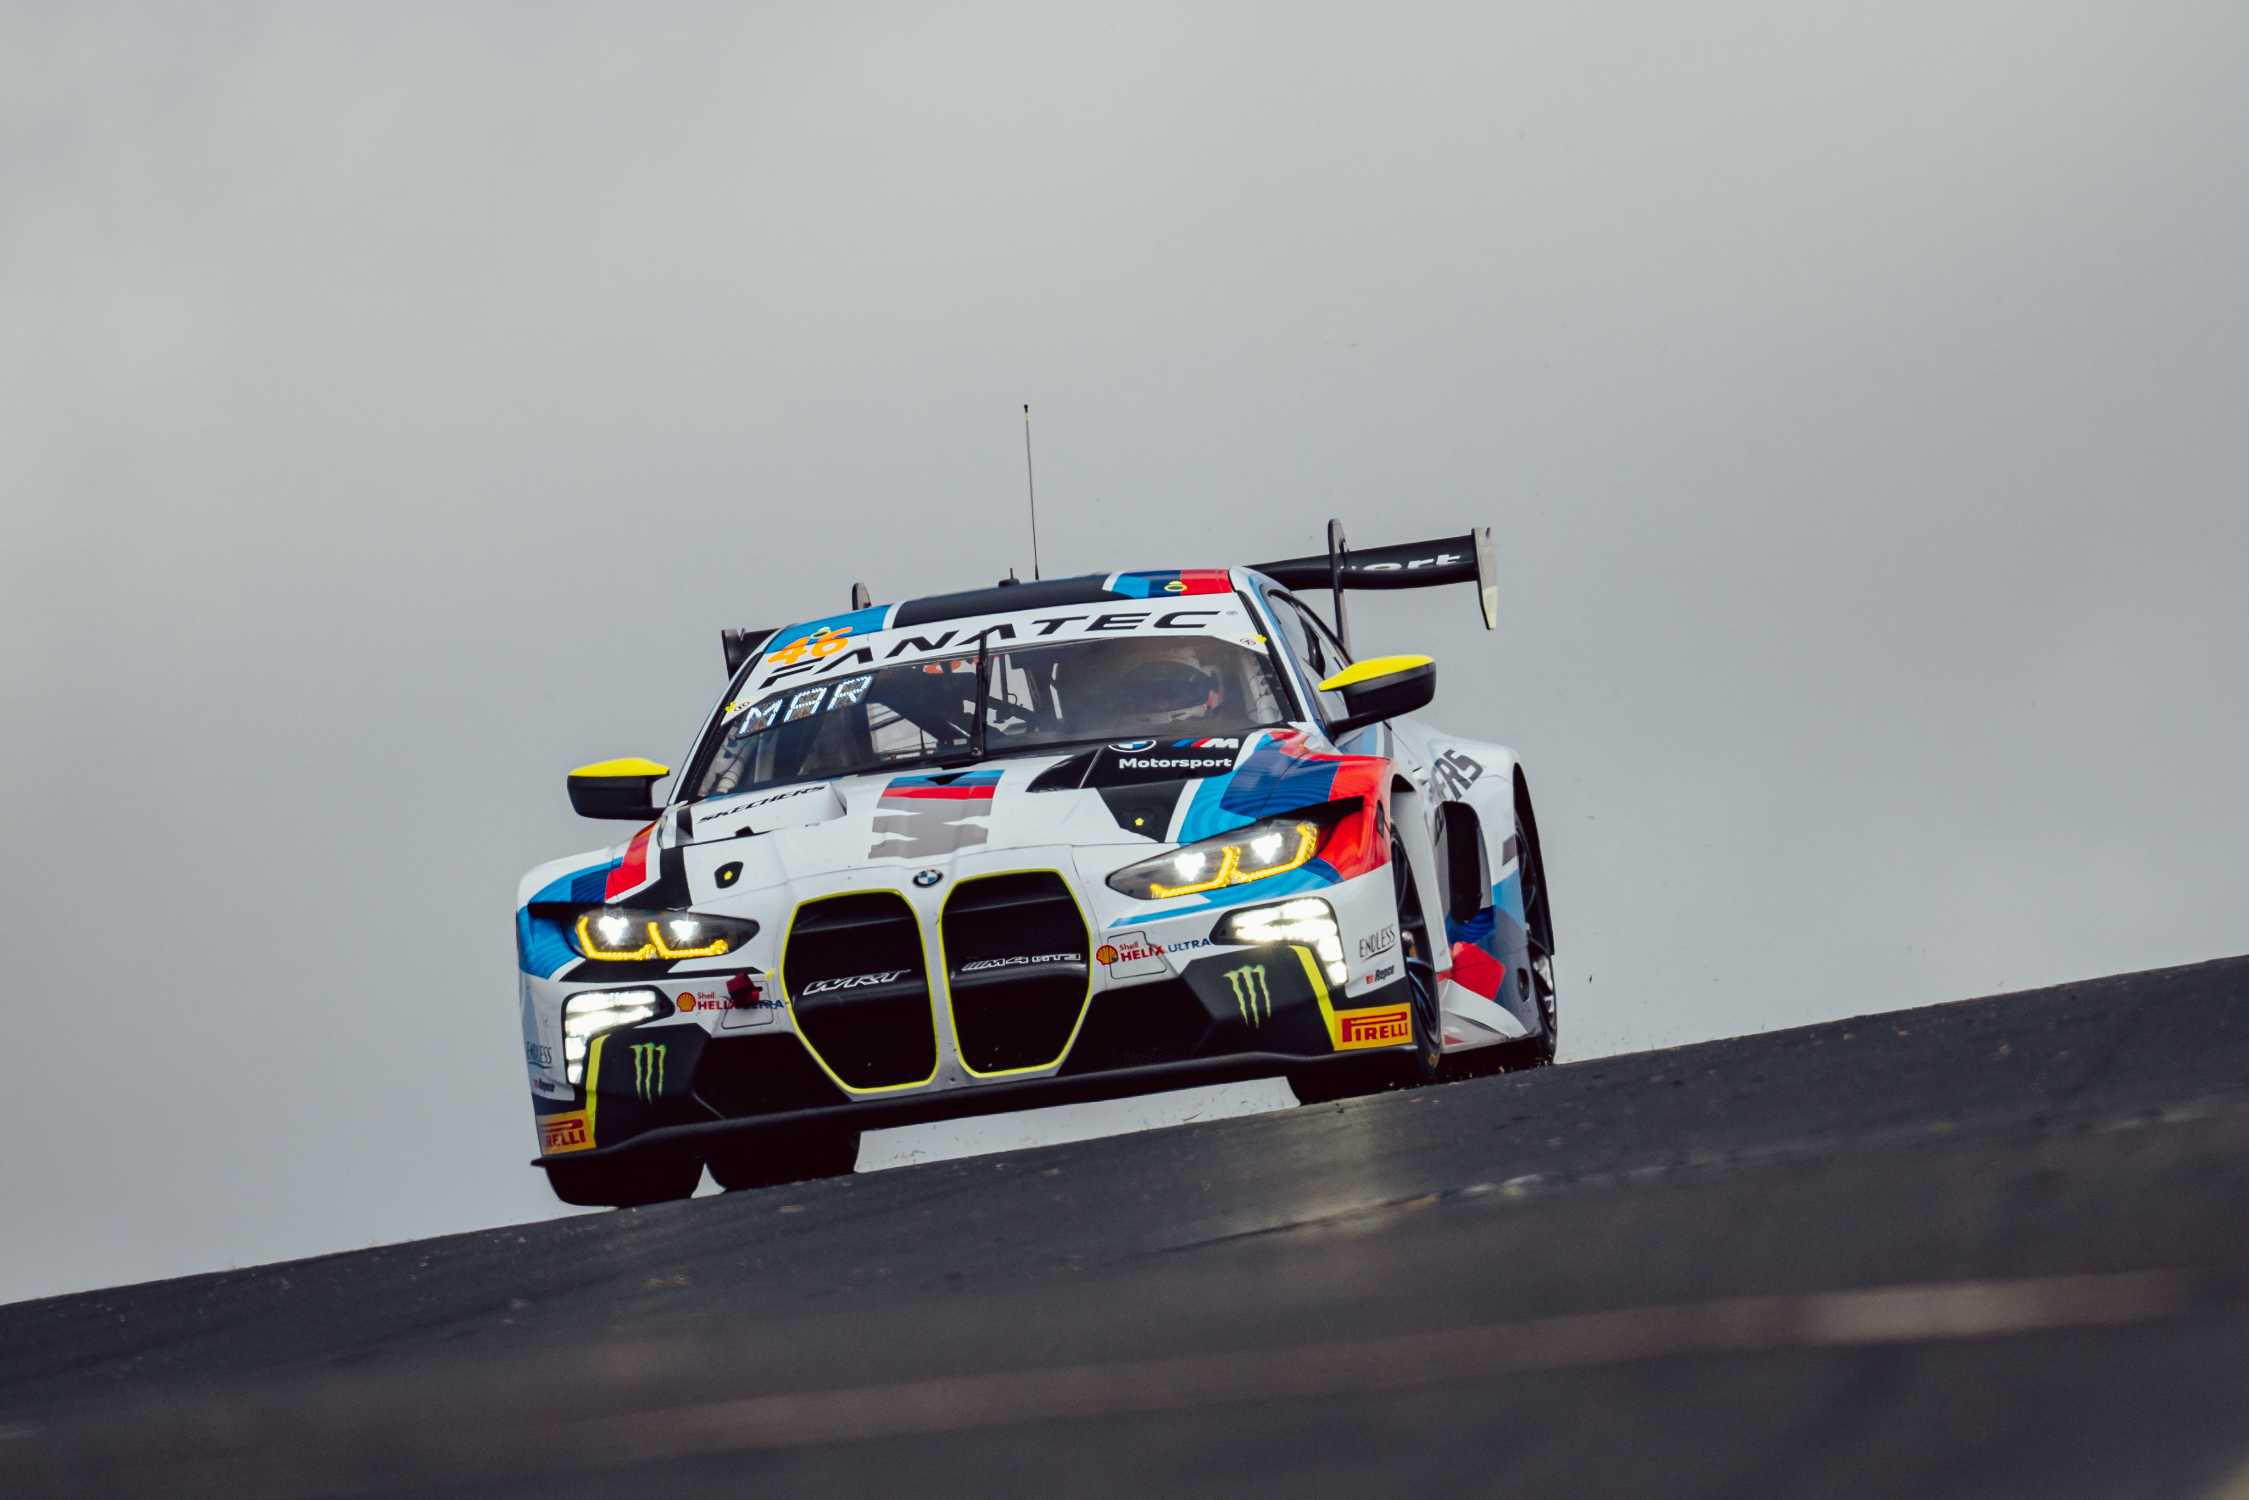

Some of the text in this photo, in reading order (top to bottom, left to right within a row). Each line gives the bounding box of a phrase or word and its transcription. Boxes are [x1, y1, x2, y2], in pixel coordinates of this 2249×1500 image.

[758, 610, 1221, 690] FANATEC
[767, 627, 853, 665] 46
[738, 675, 875, 737] MAR
[1118, 758, 1233, 769] Motorsport
[1119, 940, 1140, 952] Shell
[1120, 937, 1211, 962] HELIX ULTRA
[1358, 925, 1397, 959] ENDLESS
[1341, 1010, 1408, 1044] PIRELLI
